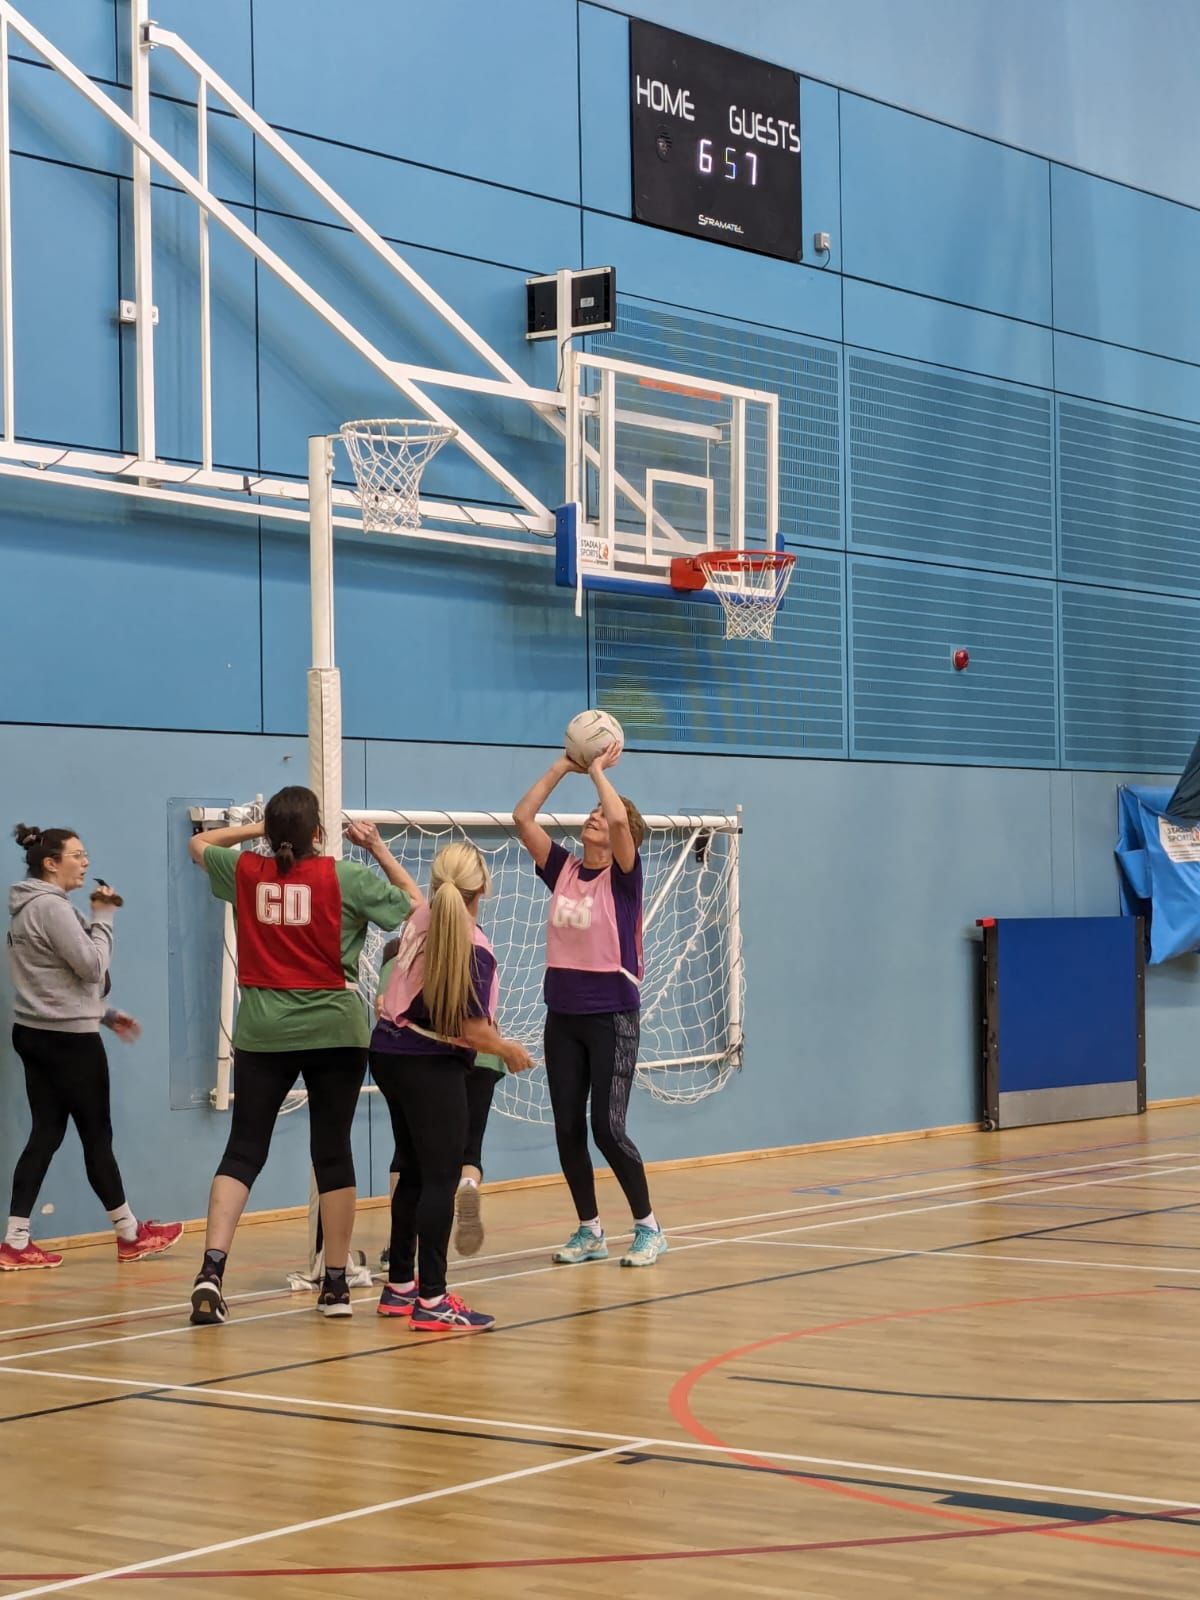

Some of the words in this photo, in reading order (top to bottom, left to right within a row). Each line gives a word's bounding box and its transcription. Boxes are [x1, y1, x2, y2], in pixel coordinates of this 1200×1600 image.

[636, 74, 695, 122] HOME
[729, 105, 801, 153] GUESTS
[699, 138, 713, 173] 6
[724, 147, 737, 180] 5
[745, 152, 757, 186] 7
[698, 214, 745, 234] STRAMATEL
[256, 882, 312, 926] GD
